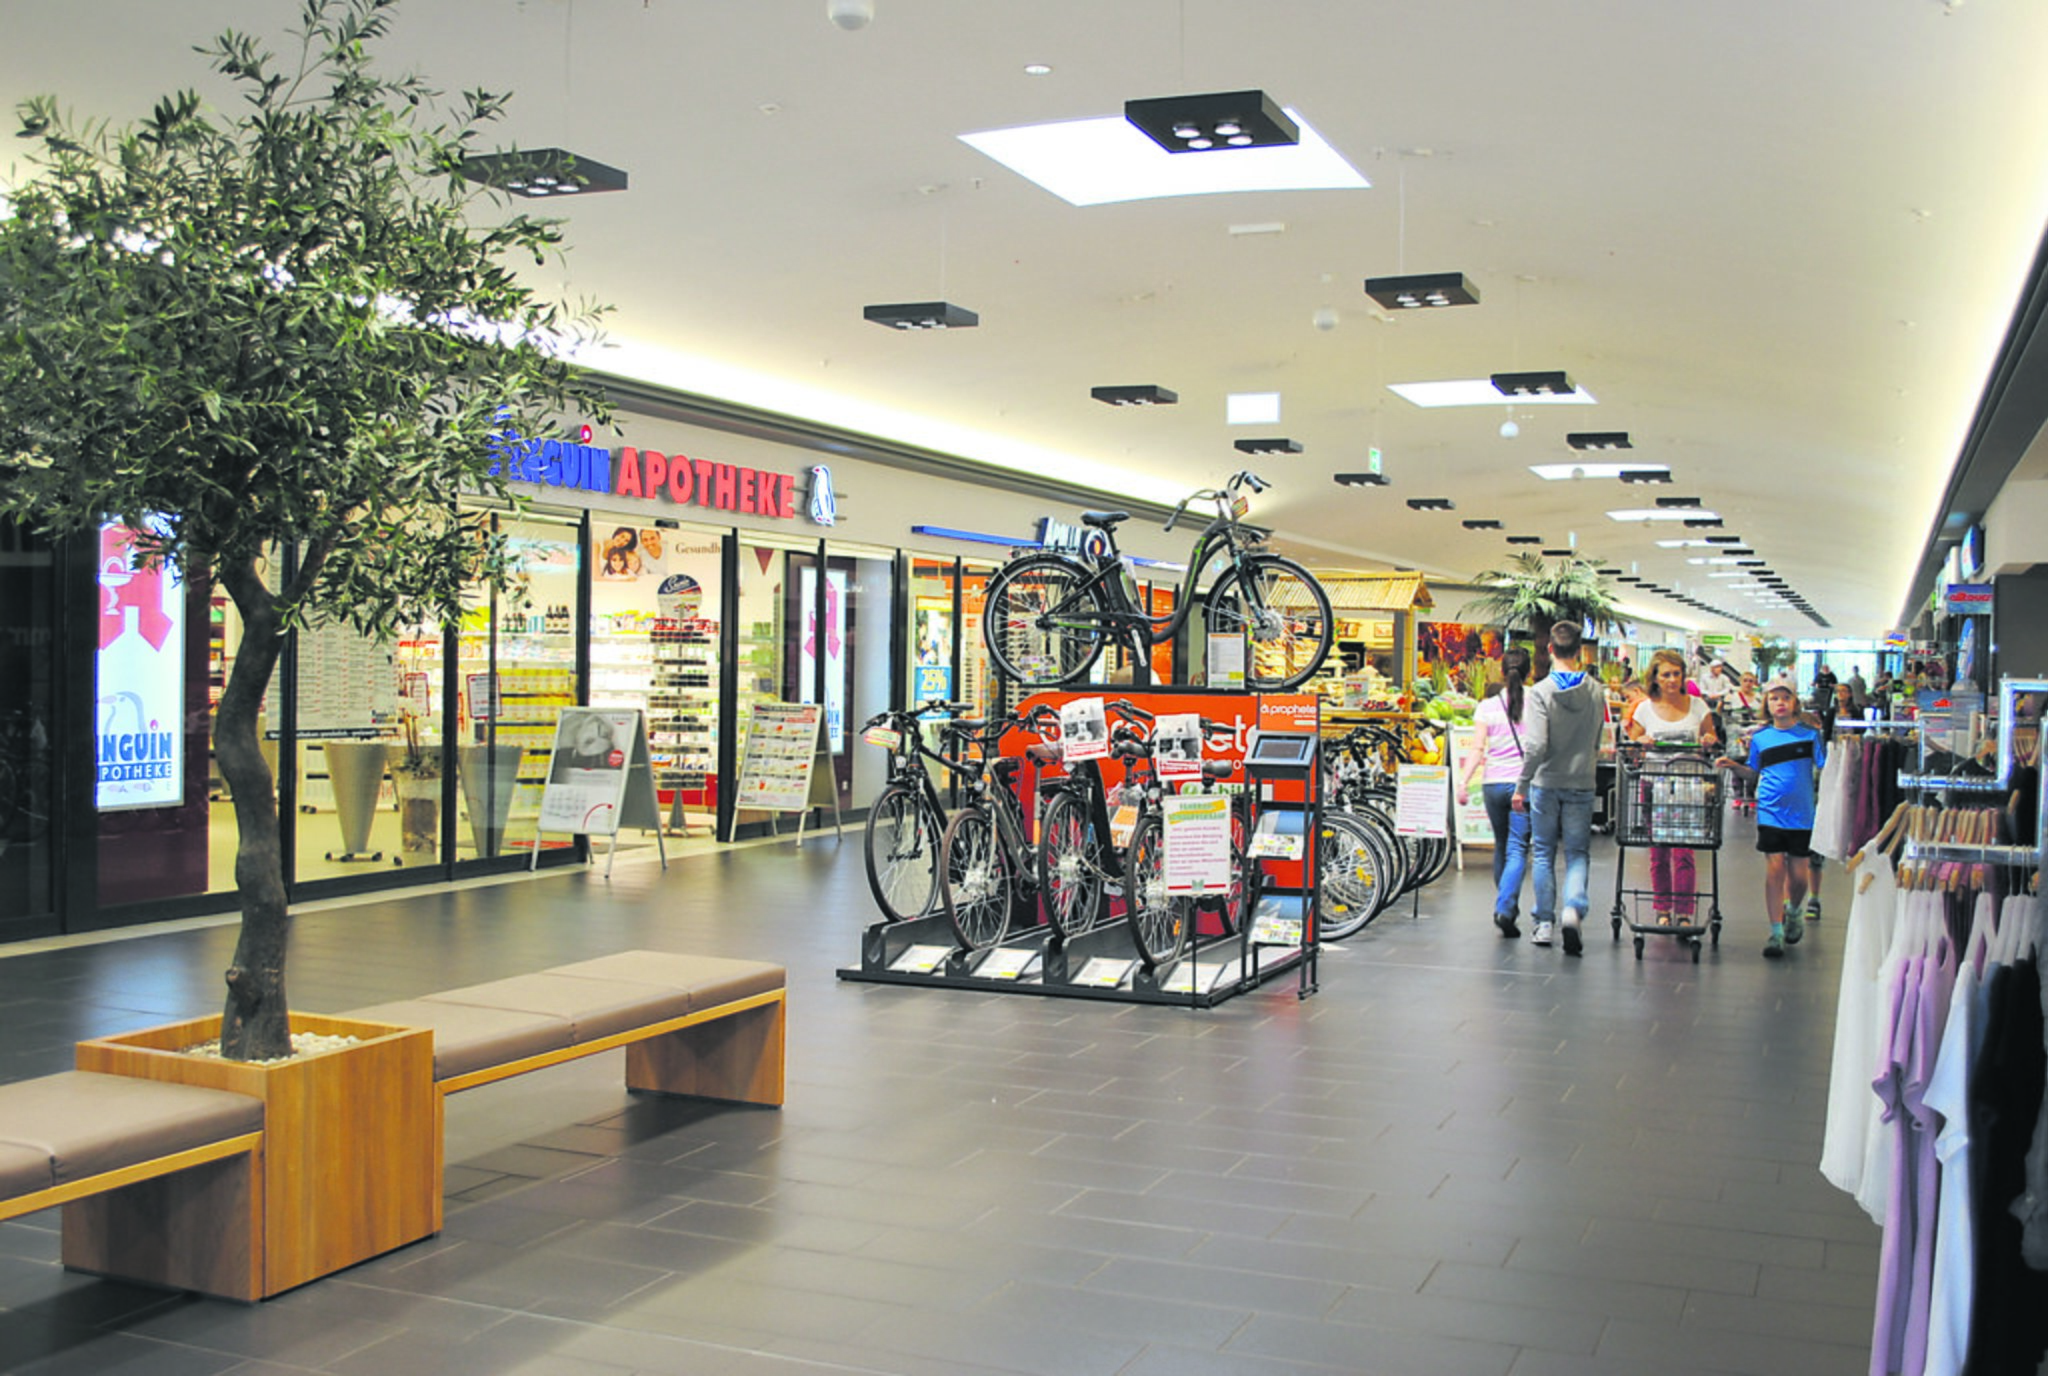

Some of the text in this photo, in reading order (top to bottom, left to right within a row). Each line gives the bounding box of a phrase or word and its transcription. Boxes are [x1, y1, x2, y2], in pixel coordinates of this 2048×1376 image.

[615, 446, 795, 519] APOTHEKE
[102, 719, 173, 763] NGUIN
[101, 763, 172, 780] POTHEKE
